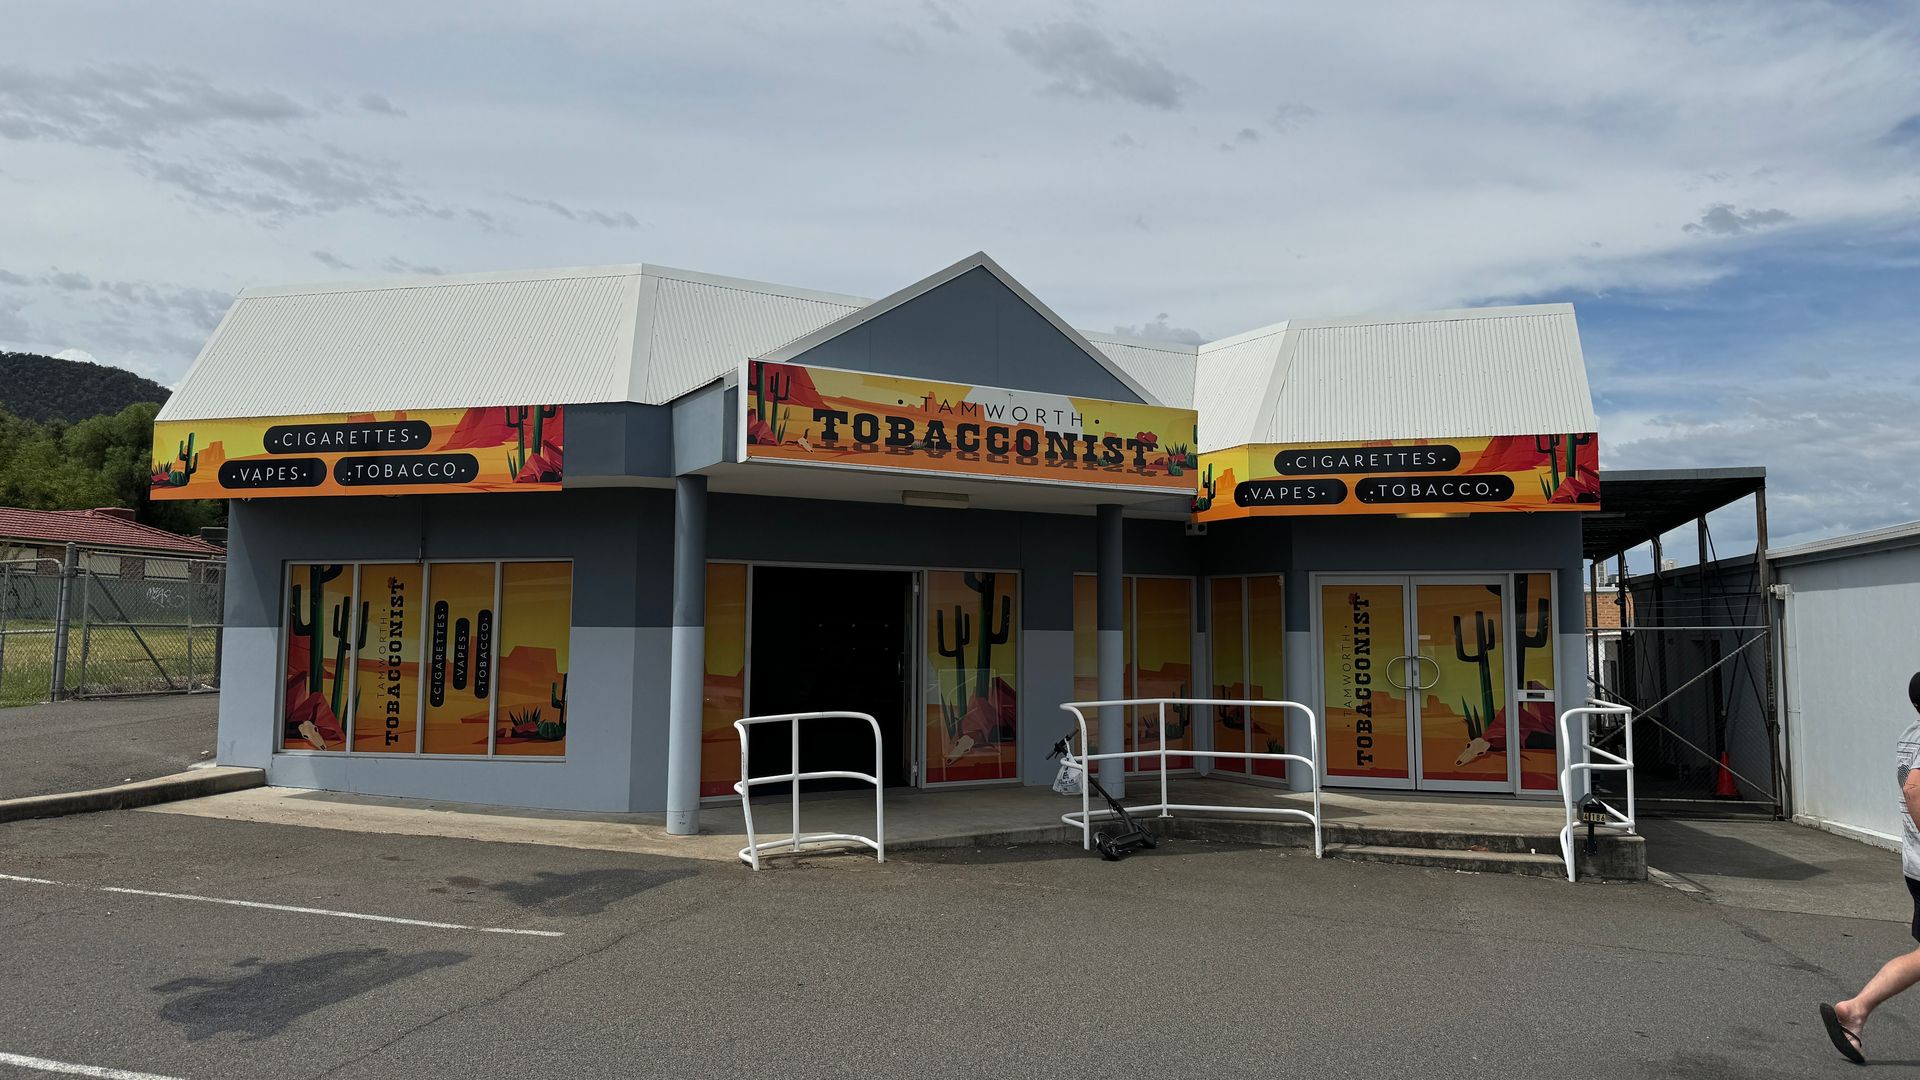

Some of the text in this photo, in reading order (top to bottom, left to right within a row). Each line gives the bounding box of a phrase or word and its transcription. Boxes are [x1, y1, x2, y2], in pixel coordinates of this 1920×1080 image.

[281, 428, 410, 448] CIGARETTES
[812, 408, 1159, 468] TOBACCONIST
[919, 396, 1084, 427] TAMWORTH
[239, 462, 456, 482] VAPES TOBACCO
[1295, 451, 1437, 470] CIGARETTES
[1250, 481, 1490, 501] VAPES TOBACCO
[376, 619, 388, 699] TAMWORTH
[385, 580, 405, 746] TOBACCONIST
[433, 613, 445, 695] CIGARETTES
[456, 635, 467, 676] VAPES
[478, 622, 489, 686] TOBACCO
[1341, 634, 1353, 717] TAMWORTH
[1353, 595, 1374, 766] TOBACCONIST
